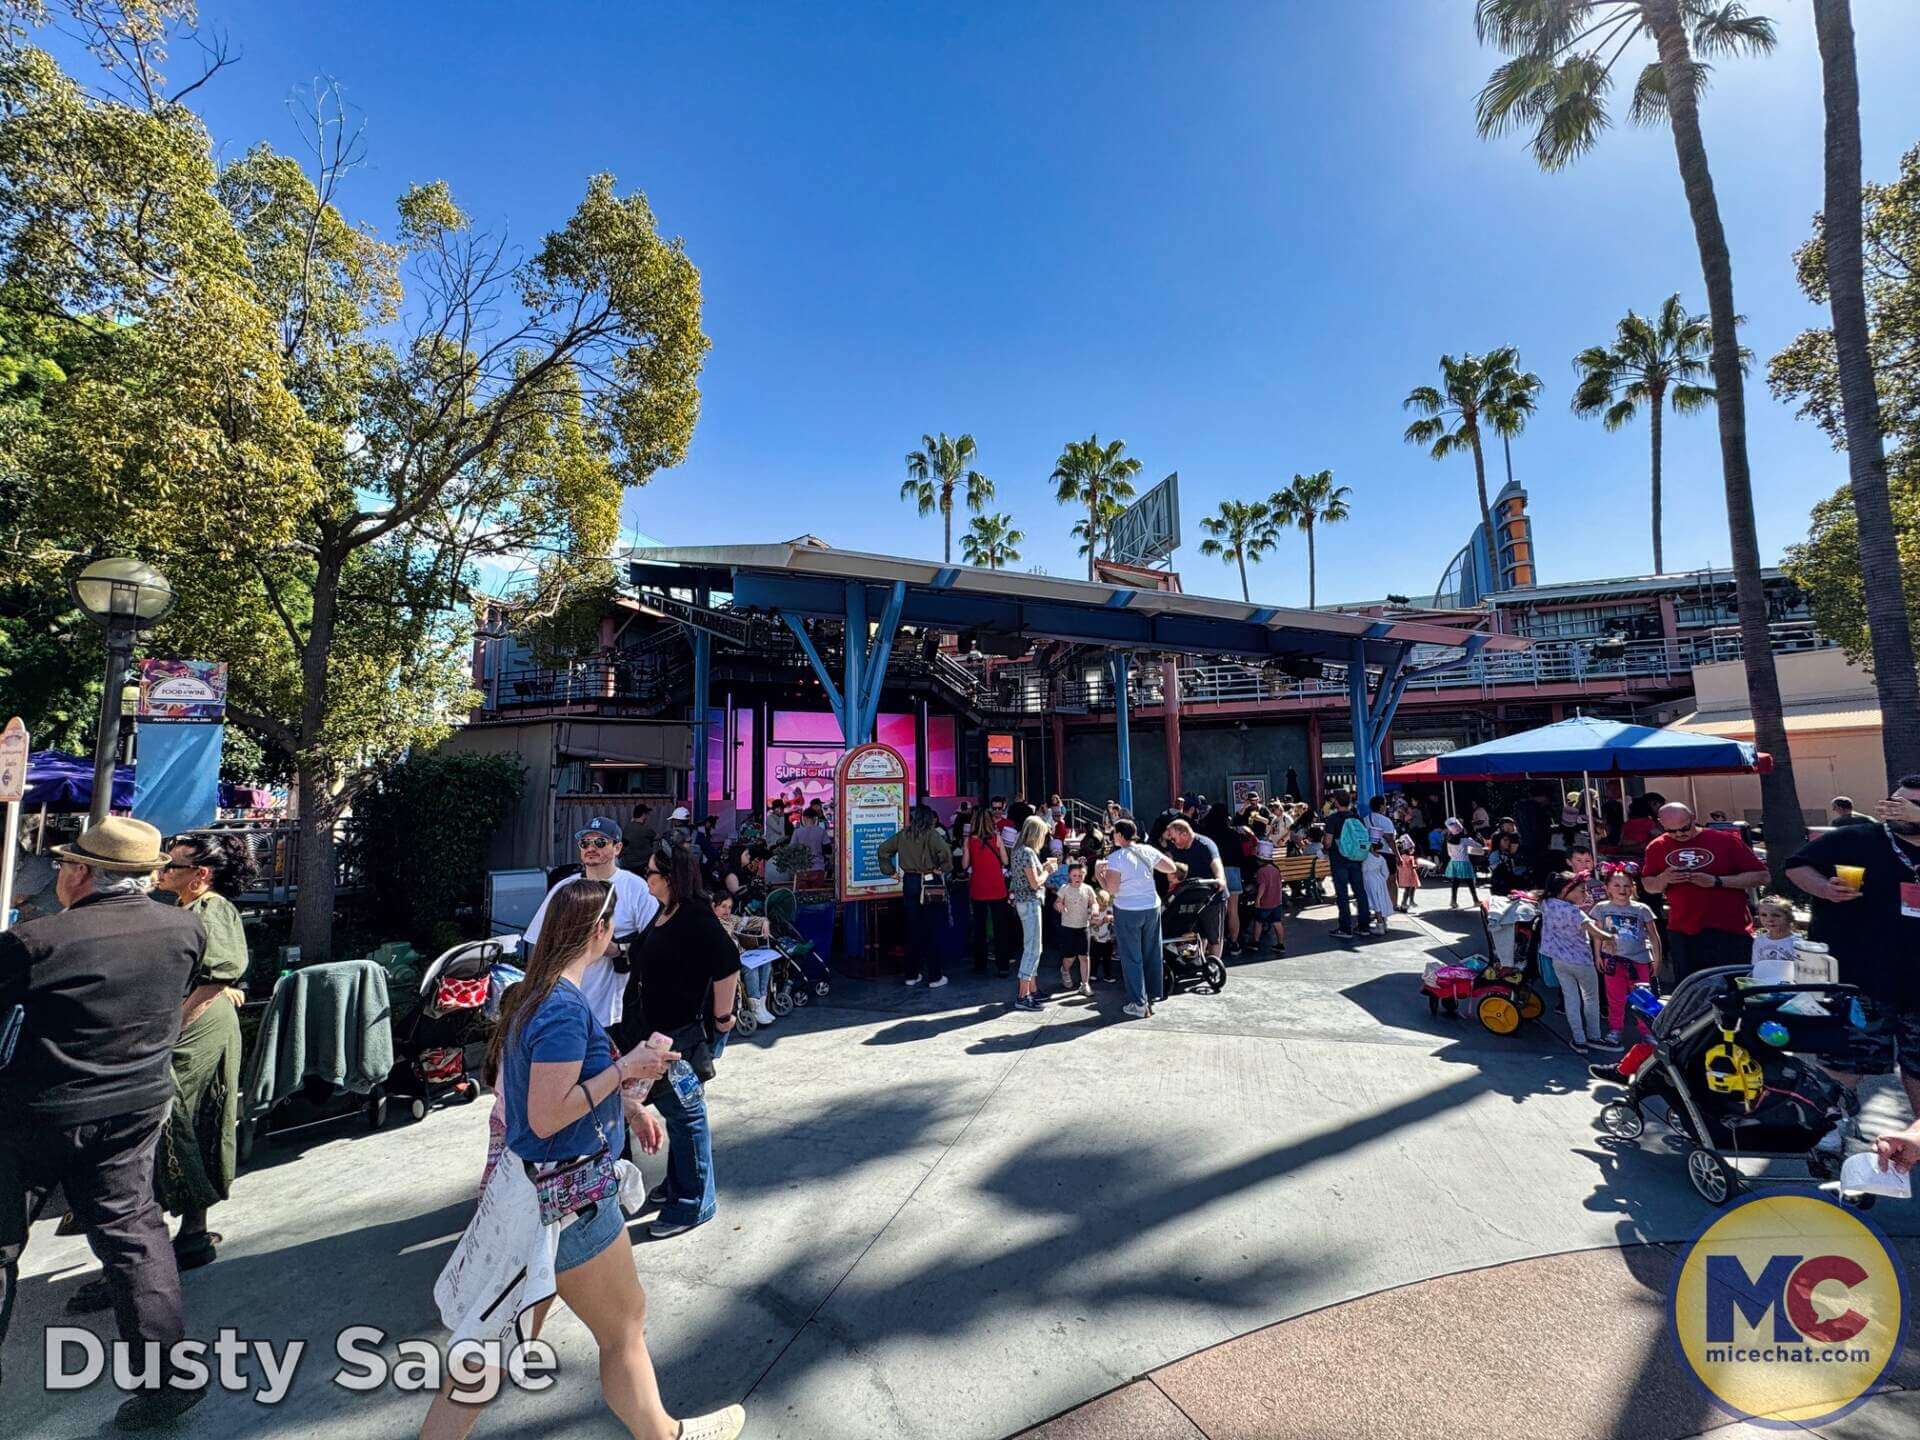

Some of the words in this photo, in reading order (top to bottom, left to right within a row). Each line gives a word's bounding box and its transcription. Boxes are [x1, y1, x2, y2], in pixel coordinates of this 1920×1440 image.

[776, 766, 807, 779] SUPER
[818, 767, 835, 777] KITT
[1678, 850, 1704, 867] SF
[391, 954, 398, 963] 7
